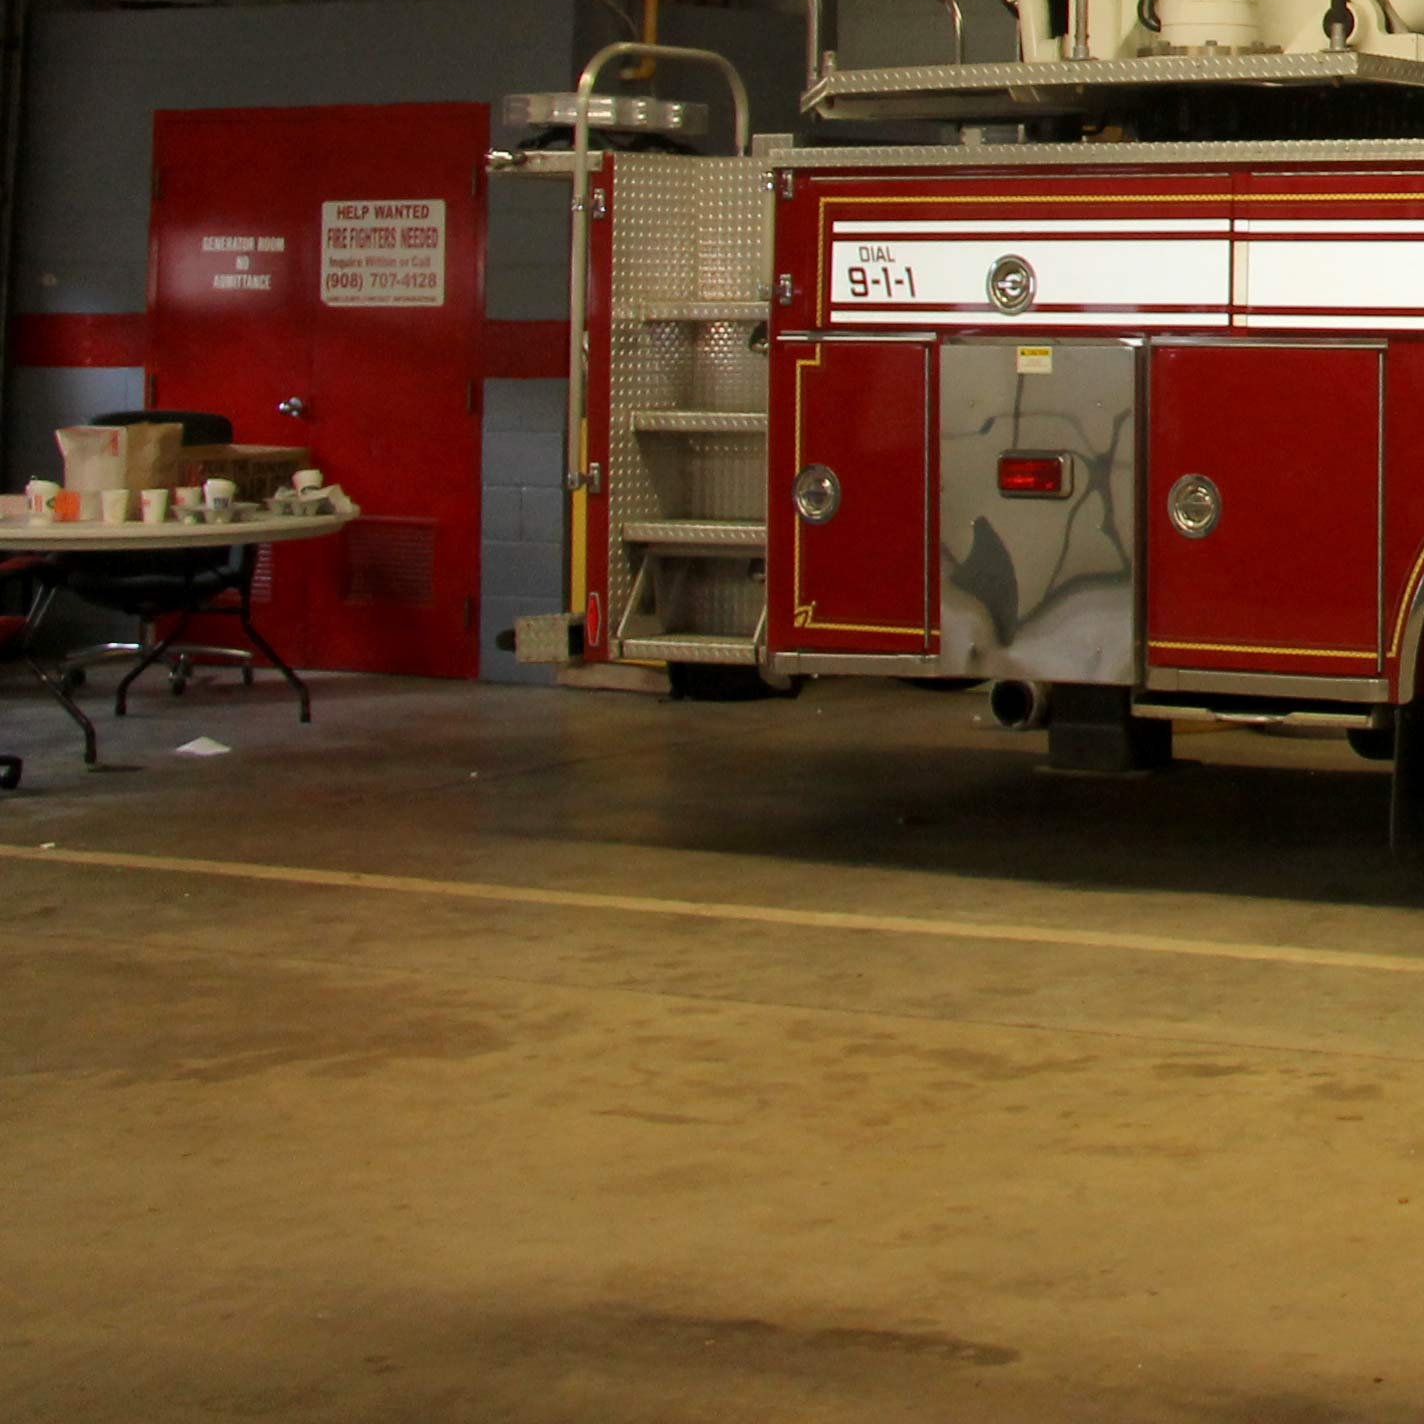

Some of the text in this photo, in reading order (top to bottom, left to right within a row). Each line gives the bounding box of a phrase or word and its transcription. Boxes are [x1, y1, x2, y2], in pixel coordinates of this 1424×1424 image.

[336, 204, 430, 219] HELP WANTED
[401, 227, 439, 249] NEEDED
[859, 246, 895, 263] DIAL
[326, 272, 364, 292] (908)
[848, 266, 916, 298] 9-1-1
